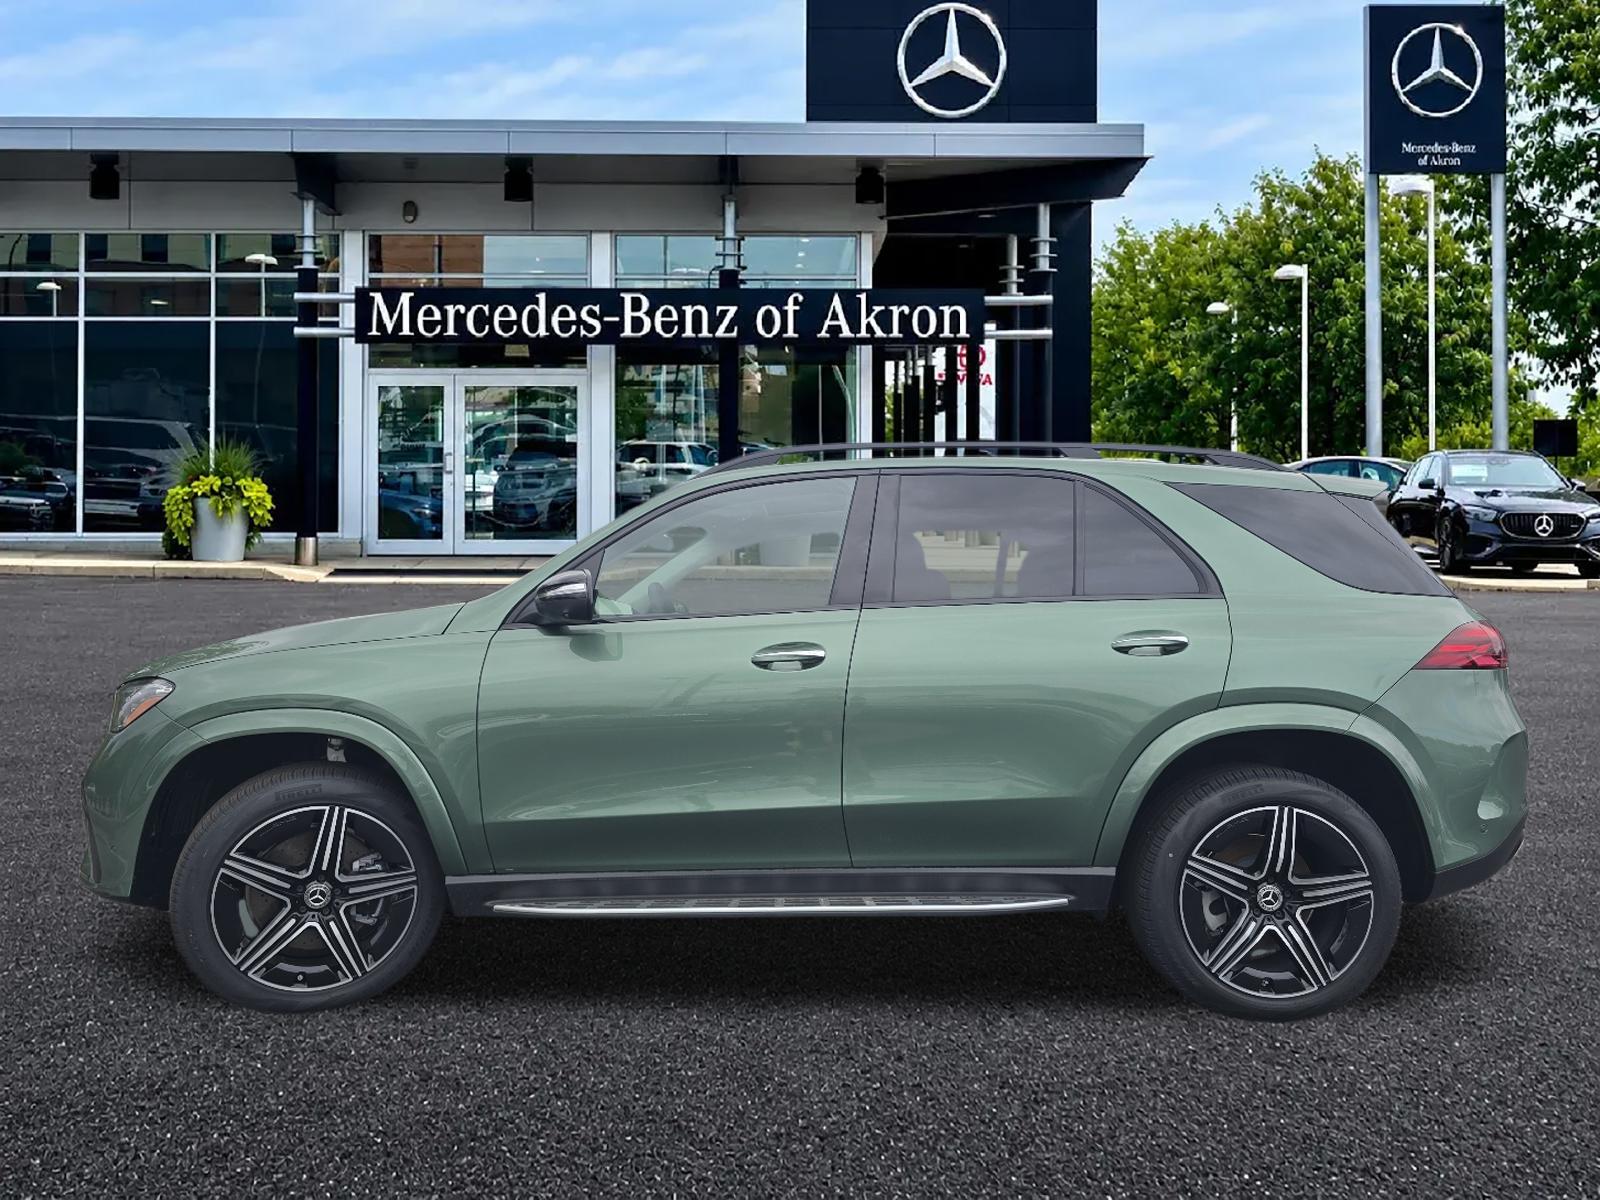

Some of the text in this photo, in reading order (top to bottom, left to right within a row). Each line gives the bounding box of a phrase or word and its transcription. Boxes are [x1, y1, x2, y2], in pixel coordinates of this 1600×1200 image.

[1401, 142, 1477, 153] Mercedes-Benz
[1417, 155, 1461, 166] of Akron
[367, 292, 971, 339] Mercedes-Benz of Akron
